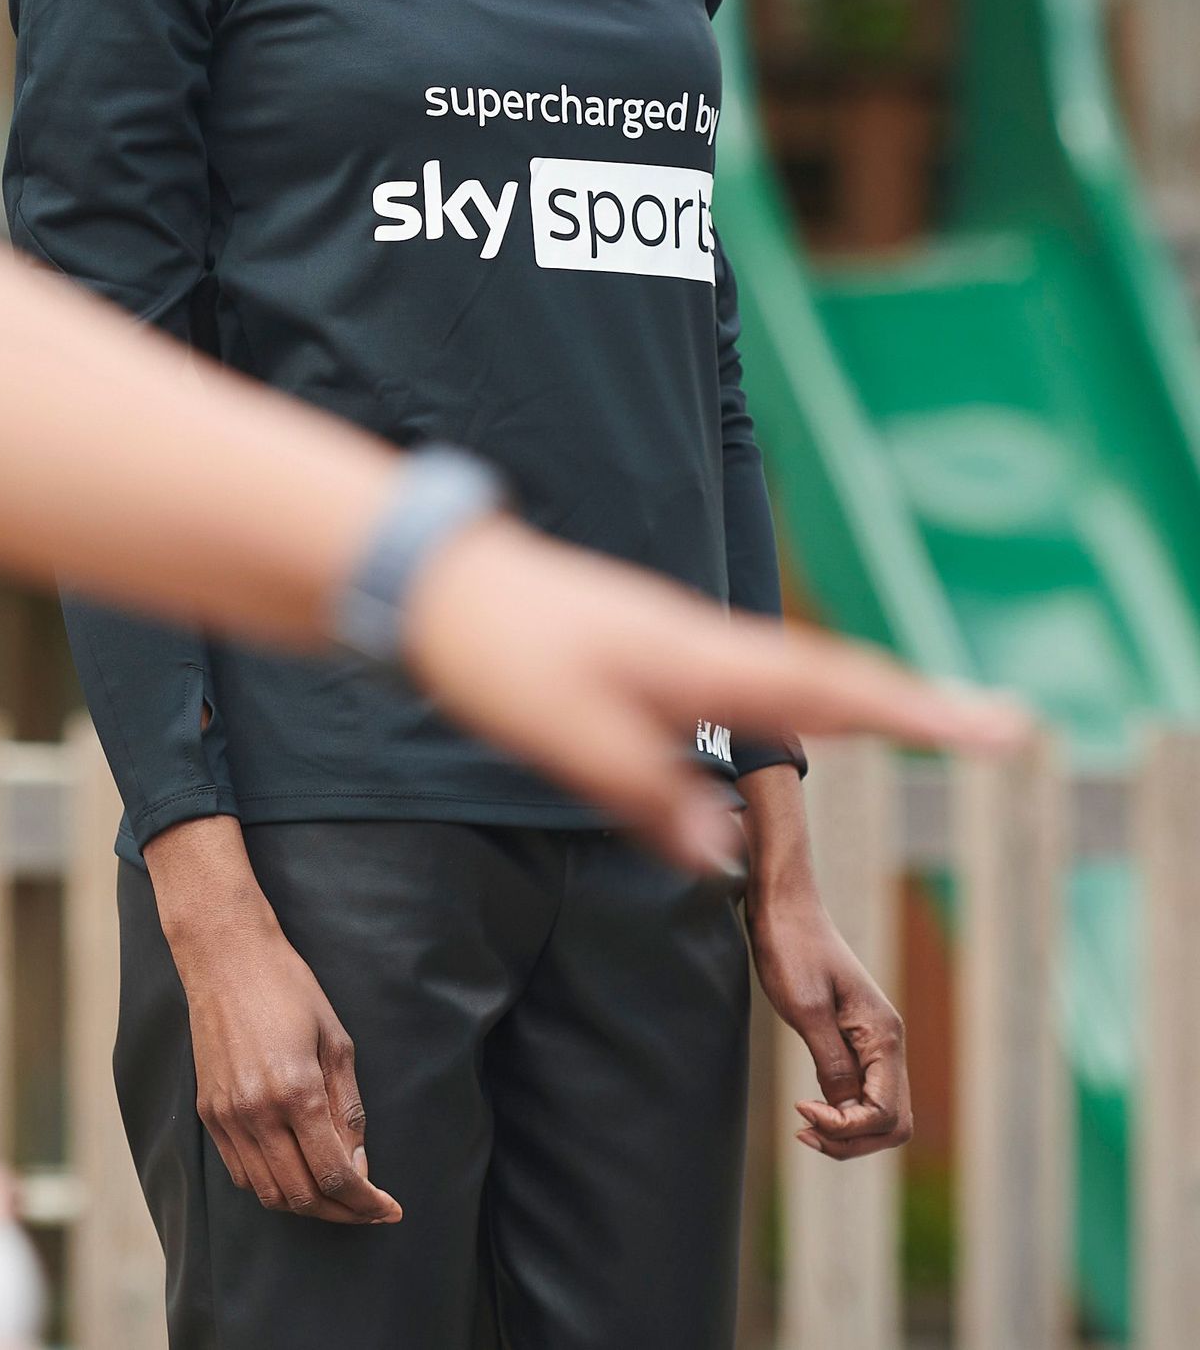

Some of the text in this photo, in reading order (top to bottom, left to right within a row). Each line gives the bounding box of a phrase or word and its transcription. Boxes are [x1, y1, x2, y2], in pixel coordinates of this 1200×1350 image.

[424, 84, 719, 145] supercharged by
[372, 159, 714, 260] sky sport
